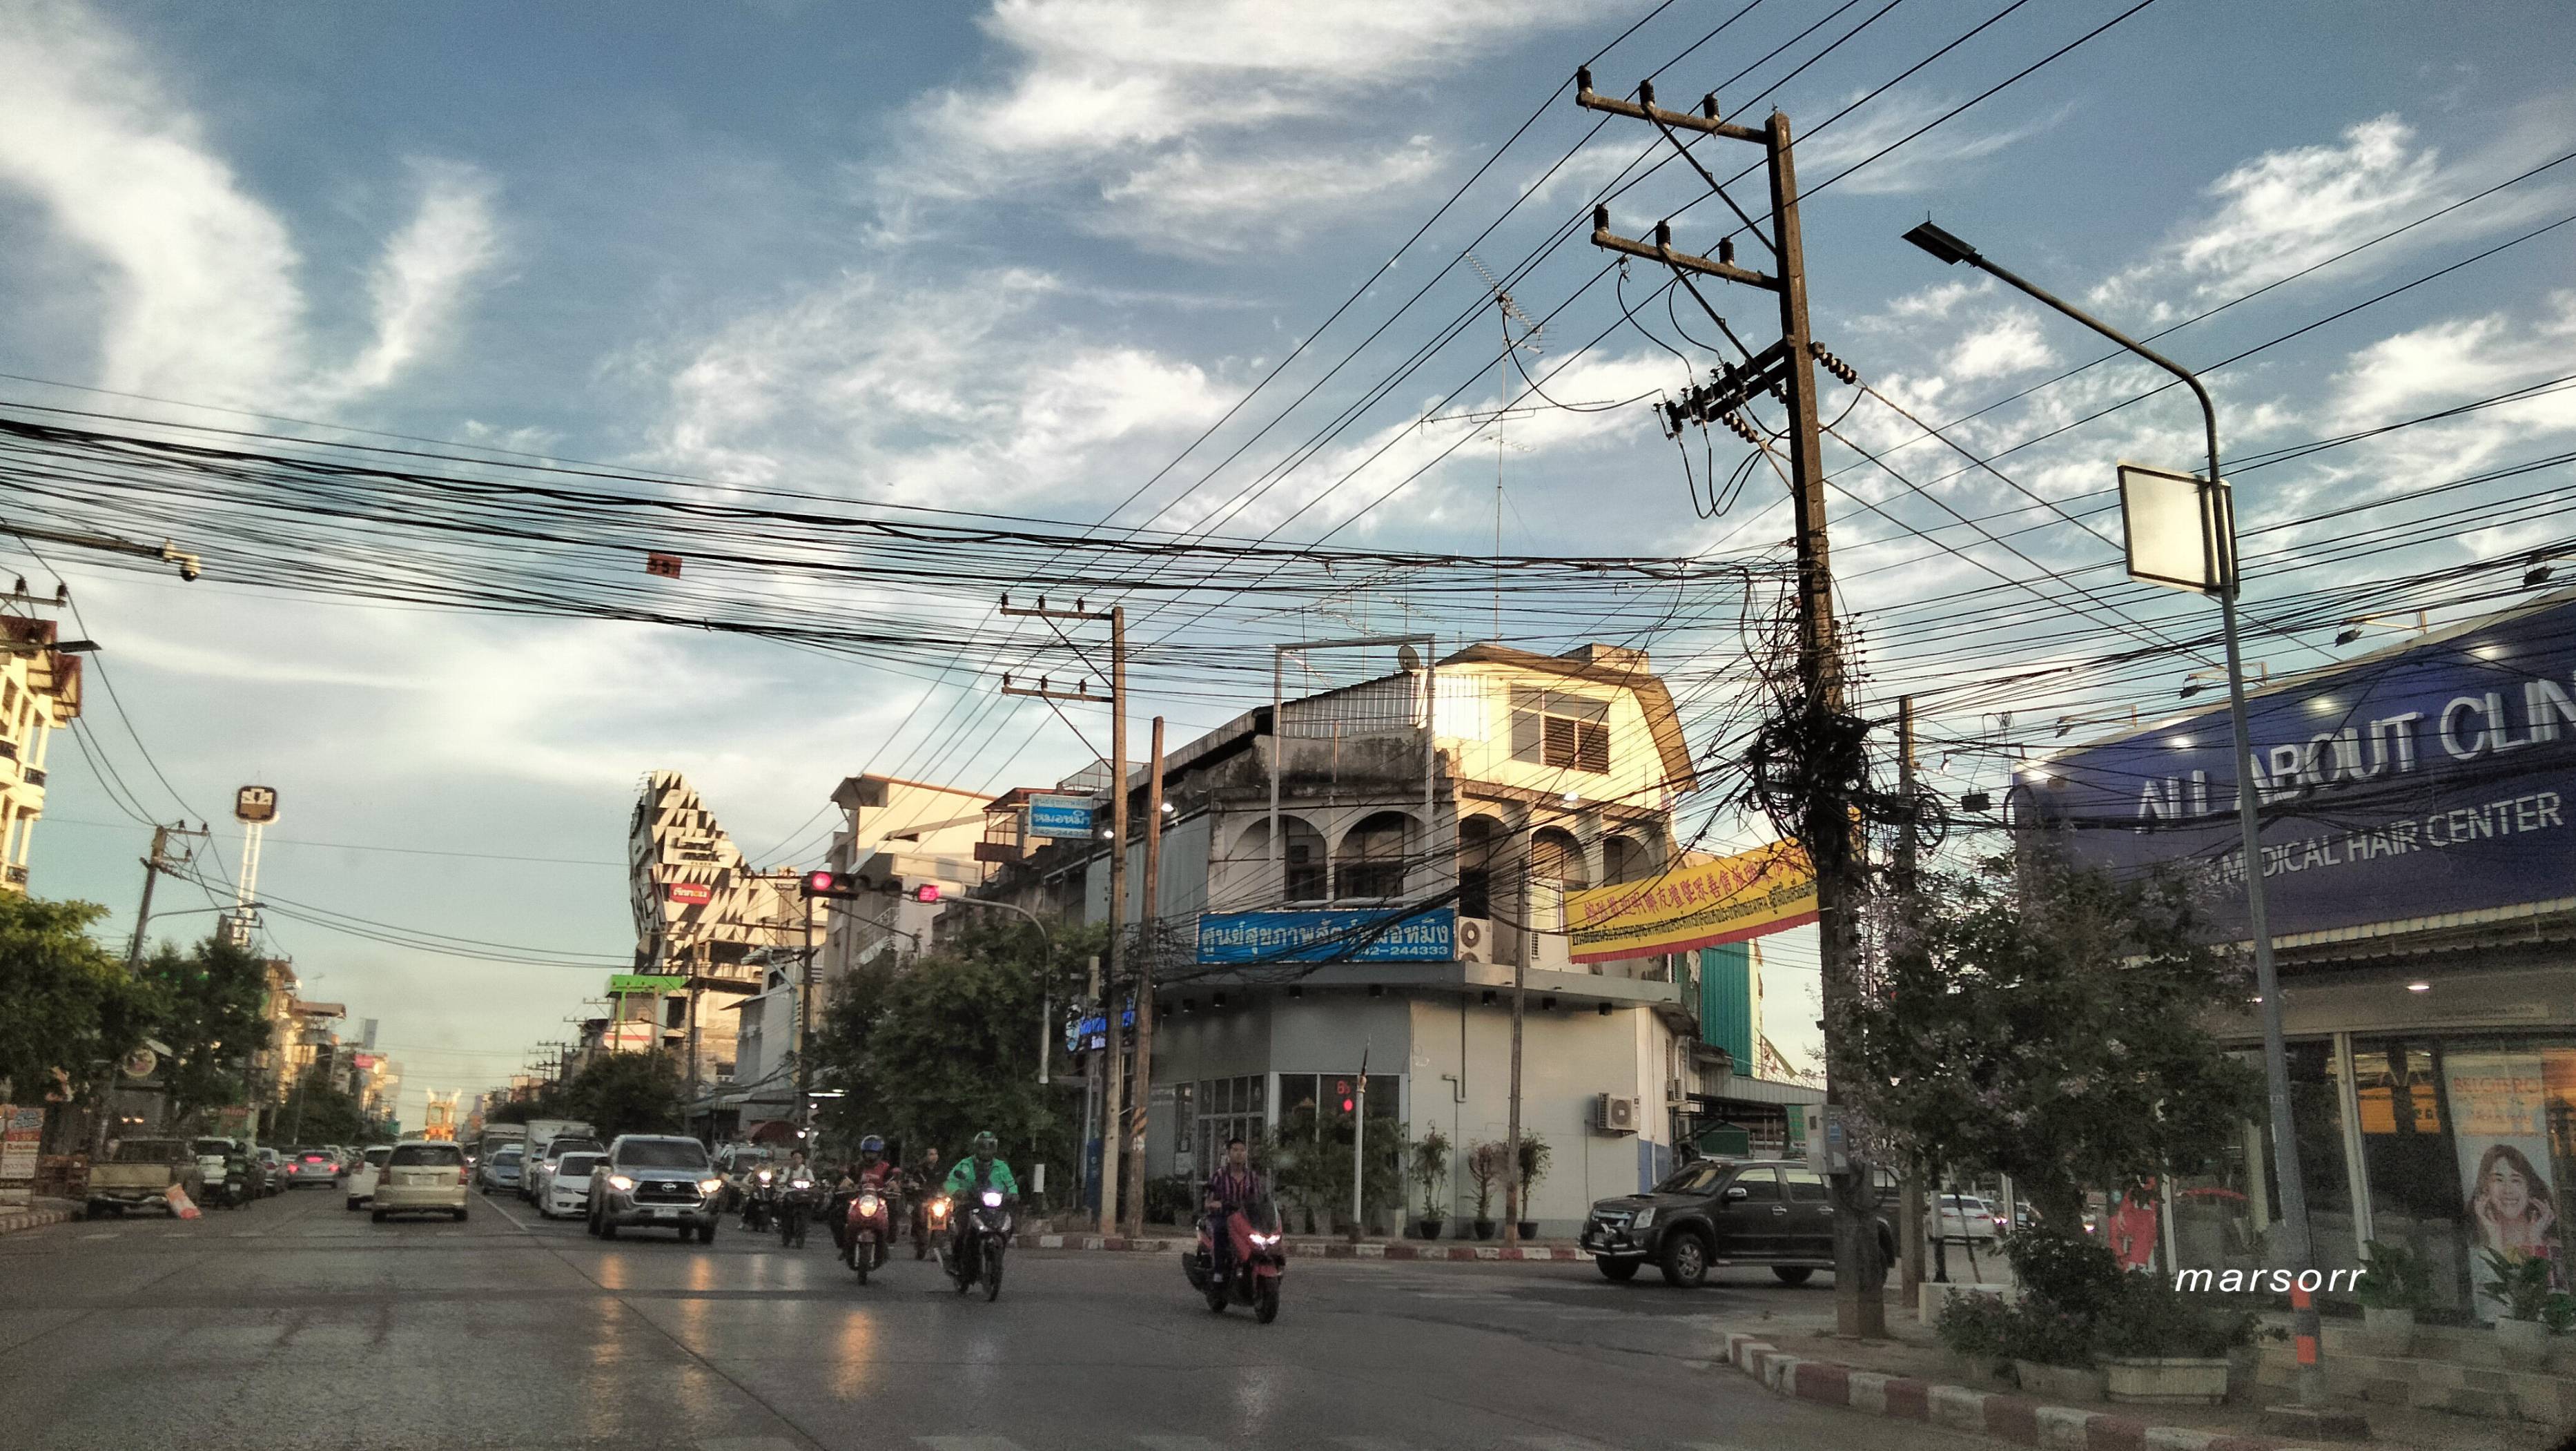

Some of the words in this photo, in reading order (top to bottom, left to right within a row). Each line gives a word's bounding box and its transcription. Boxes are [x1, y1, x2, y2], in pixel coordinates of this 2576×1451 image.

[2222, 835, 2342, 885] MDICAL
[2347, 820, 2421, 860] HAIR
[2426, 792, 2564, 847] CENTER
[1354, 946, 1449, 956] 42-244333
